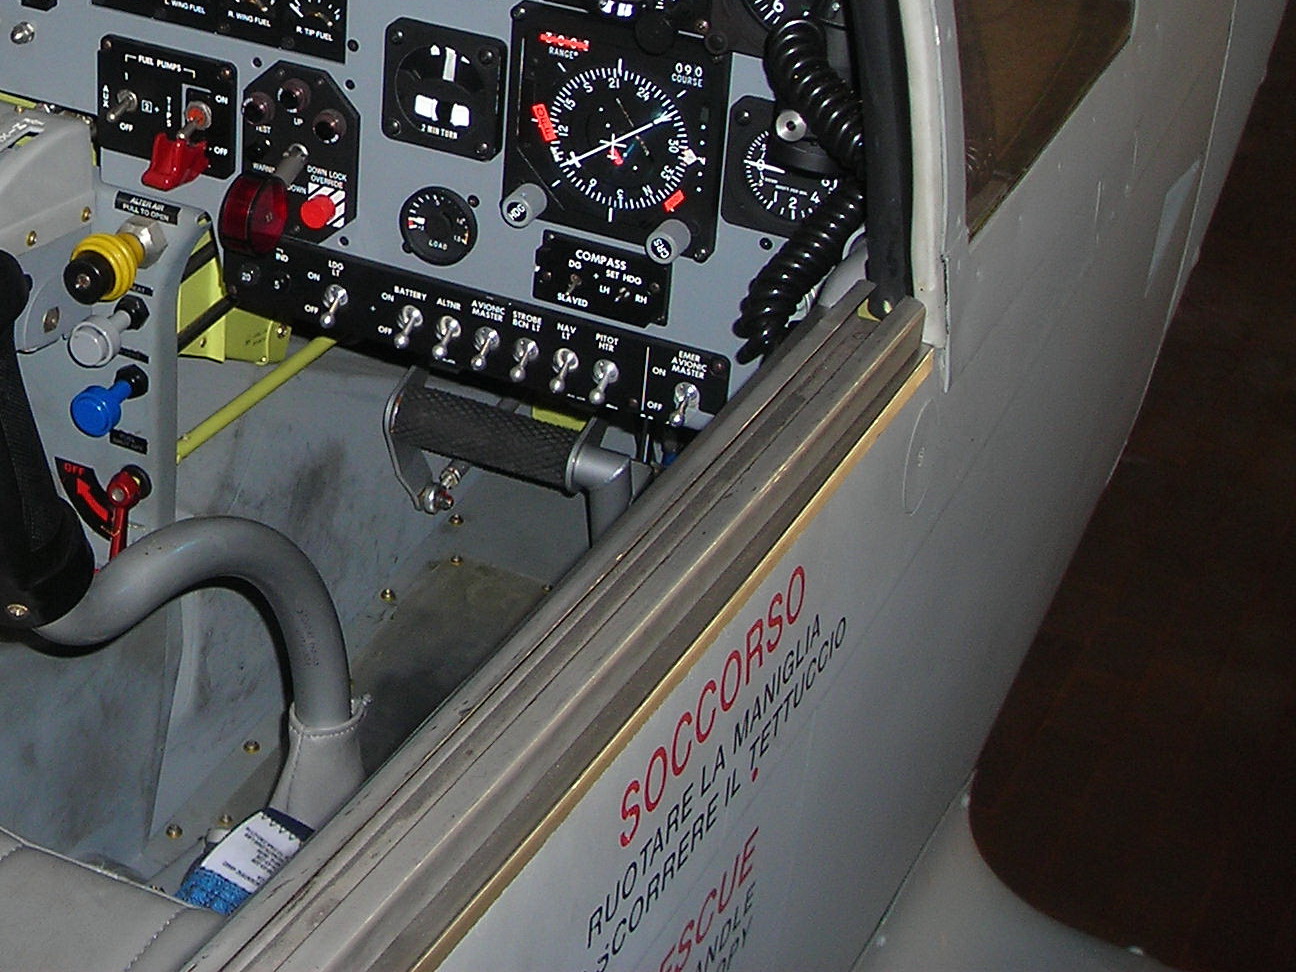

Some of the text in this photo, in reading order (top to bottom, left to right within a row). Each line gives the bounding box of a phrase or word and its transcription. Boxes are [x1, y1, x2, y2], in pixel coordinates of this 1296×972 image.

[171, 0, 206, 15] WING FUEL
[235, 12, 271, 28] WING FUEL
[303, 27, 333, 42] TIP FUEL
[548, 46, 573, 60] RANGE
[138, 55, 182, 73] FUEL PUMPS
[608, 77, 621, 90] 21
[670, 73, 704, 89] COURSE
[214, 94, 229, 105] ON
[636, 85, 651, 101] 24
[563, 98, 577, 111] 15
[119, 121, 134, 133] OFF
[294, 117, 304, 127] UP
[427, 125, 458, 140] MIN TURN
[557, 124, 570, 137] 12
[213, 146, 229, 156] OFF
[306, 164, 348, 181] DOWN LOCK
[310, 174, 344, 189] OVERRIDE
[788, 196, 798, 210] 2
[122, 202, 170, 223] PULL TO OPEN
[428, 239, 449, 251] LOAD
[328, 260, 344, 271] LDG
[568, 259, 583, 270] DG
[575, 249, 628, 271] COMPASS
[241, 272, 252, 283] 20
[307, 271, 320, 282] ON
[331, 269, 341, 277] LT
[605, 269, 642, 286] SET HDG
[394, 285, 428, 301] BATTERY
[599, 284, 611, 295] LH
[381, 292, 395, 303] ON
[436, 297, 462, 311] ALTNR
[557, 292, 589, 308] SLAVED
[634, 294, 648, 306] RH
[304, 304, 319, 315] OFF
[471, 299, 506, 316] AVIONIC
[471, 308, 504, 323] MASTER
[512, 310, 543, 325] STROBE
[377, 325, 393, 335] OFF
[512, 318, 542, 333] BCN LT
[557, 323, 577, 335] NAV
[561, 331, 571, 341] LT
[595, 332, 620, 345] PITOT
[598, 341, 615, 353] HTR
[678, 350, 701, 362] EMER
[670, 355, 708, 372] AVIONIC
[651, 366, 667, 376] ON
[671, 364, 705, 380] MASTER
[646, 400, 663, 412] OFF
[64, 462, 85, 476] OFF
[620, 565, 806, 848] SOCCORSO
[725, 768, 741, 807] IL
[749, 617, 847, 772] TETTUCCIO
[586, 613, 821, 949] RUOTARE LA MANIGLIA
